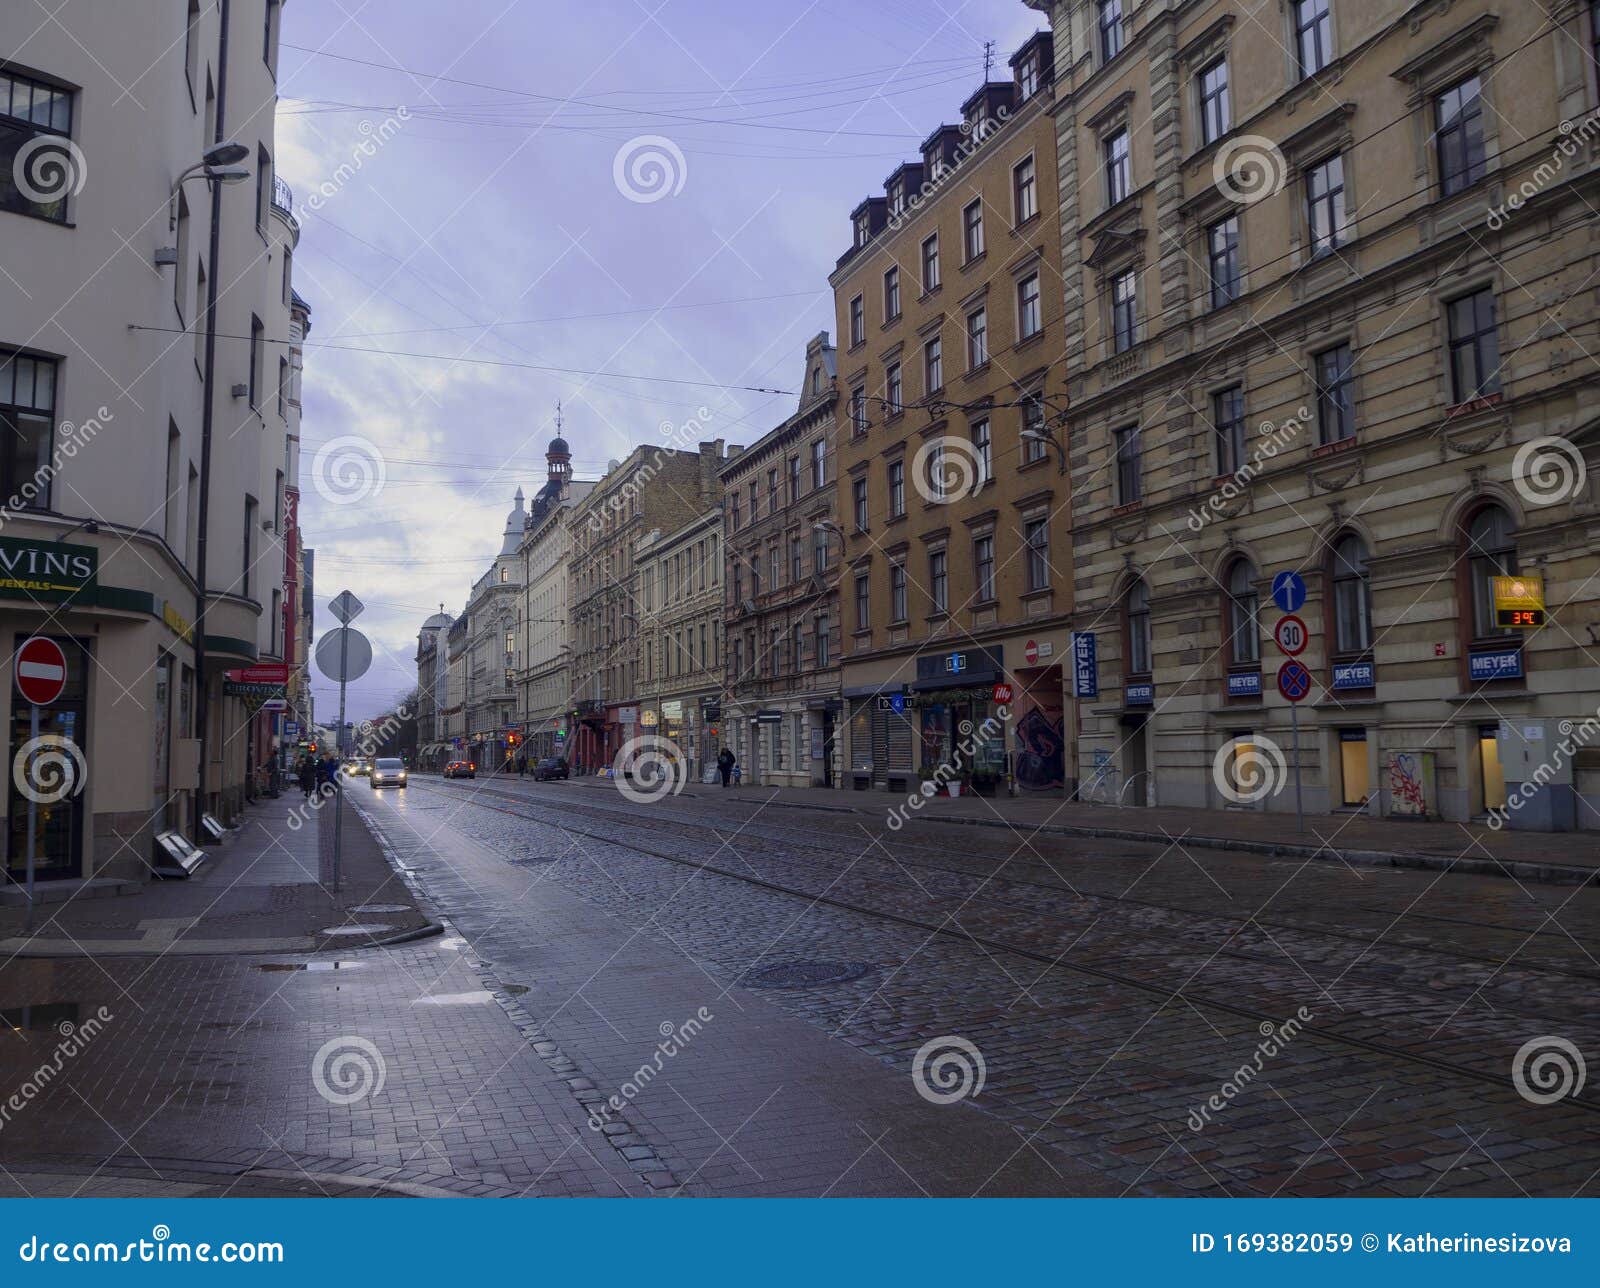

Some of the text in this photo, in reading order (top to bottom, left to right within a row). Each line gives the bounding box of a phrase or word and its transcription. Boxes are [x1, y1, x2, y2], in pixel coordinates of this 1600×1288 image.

[1283, 626, 1300, 646] 30
[1077, 637, 1090, 694] MEYER
[1472, 655, 1517, 670] MEYER
[1334, 667, 1371, 680] MEYER
[1229, 676, 1258, 688] MEYER
[996, 687, 1011, 701] illy
[1127, 687, 1150, 697] MEYER
